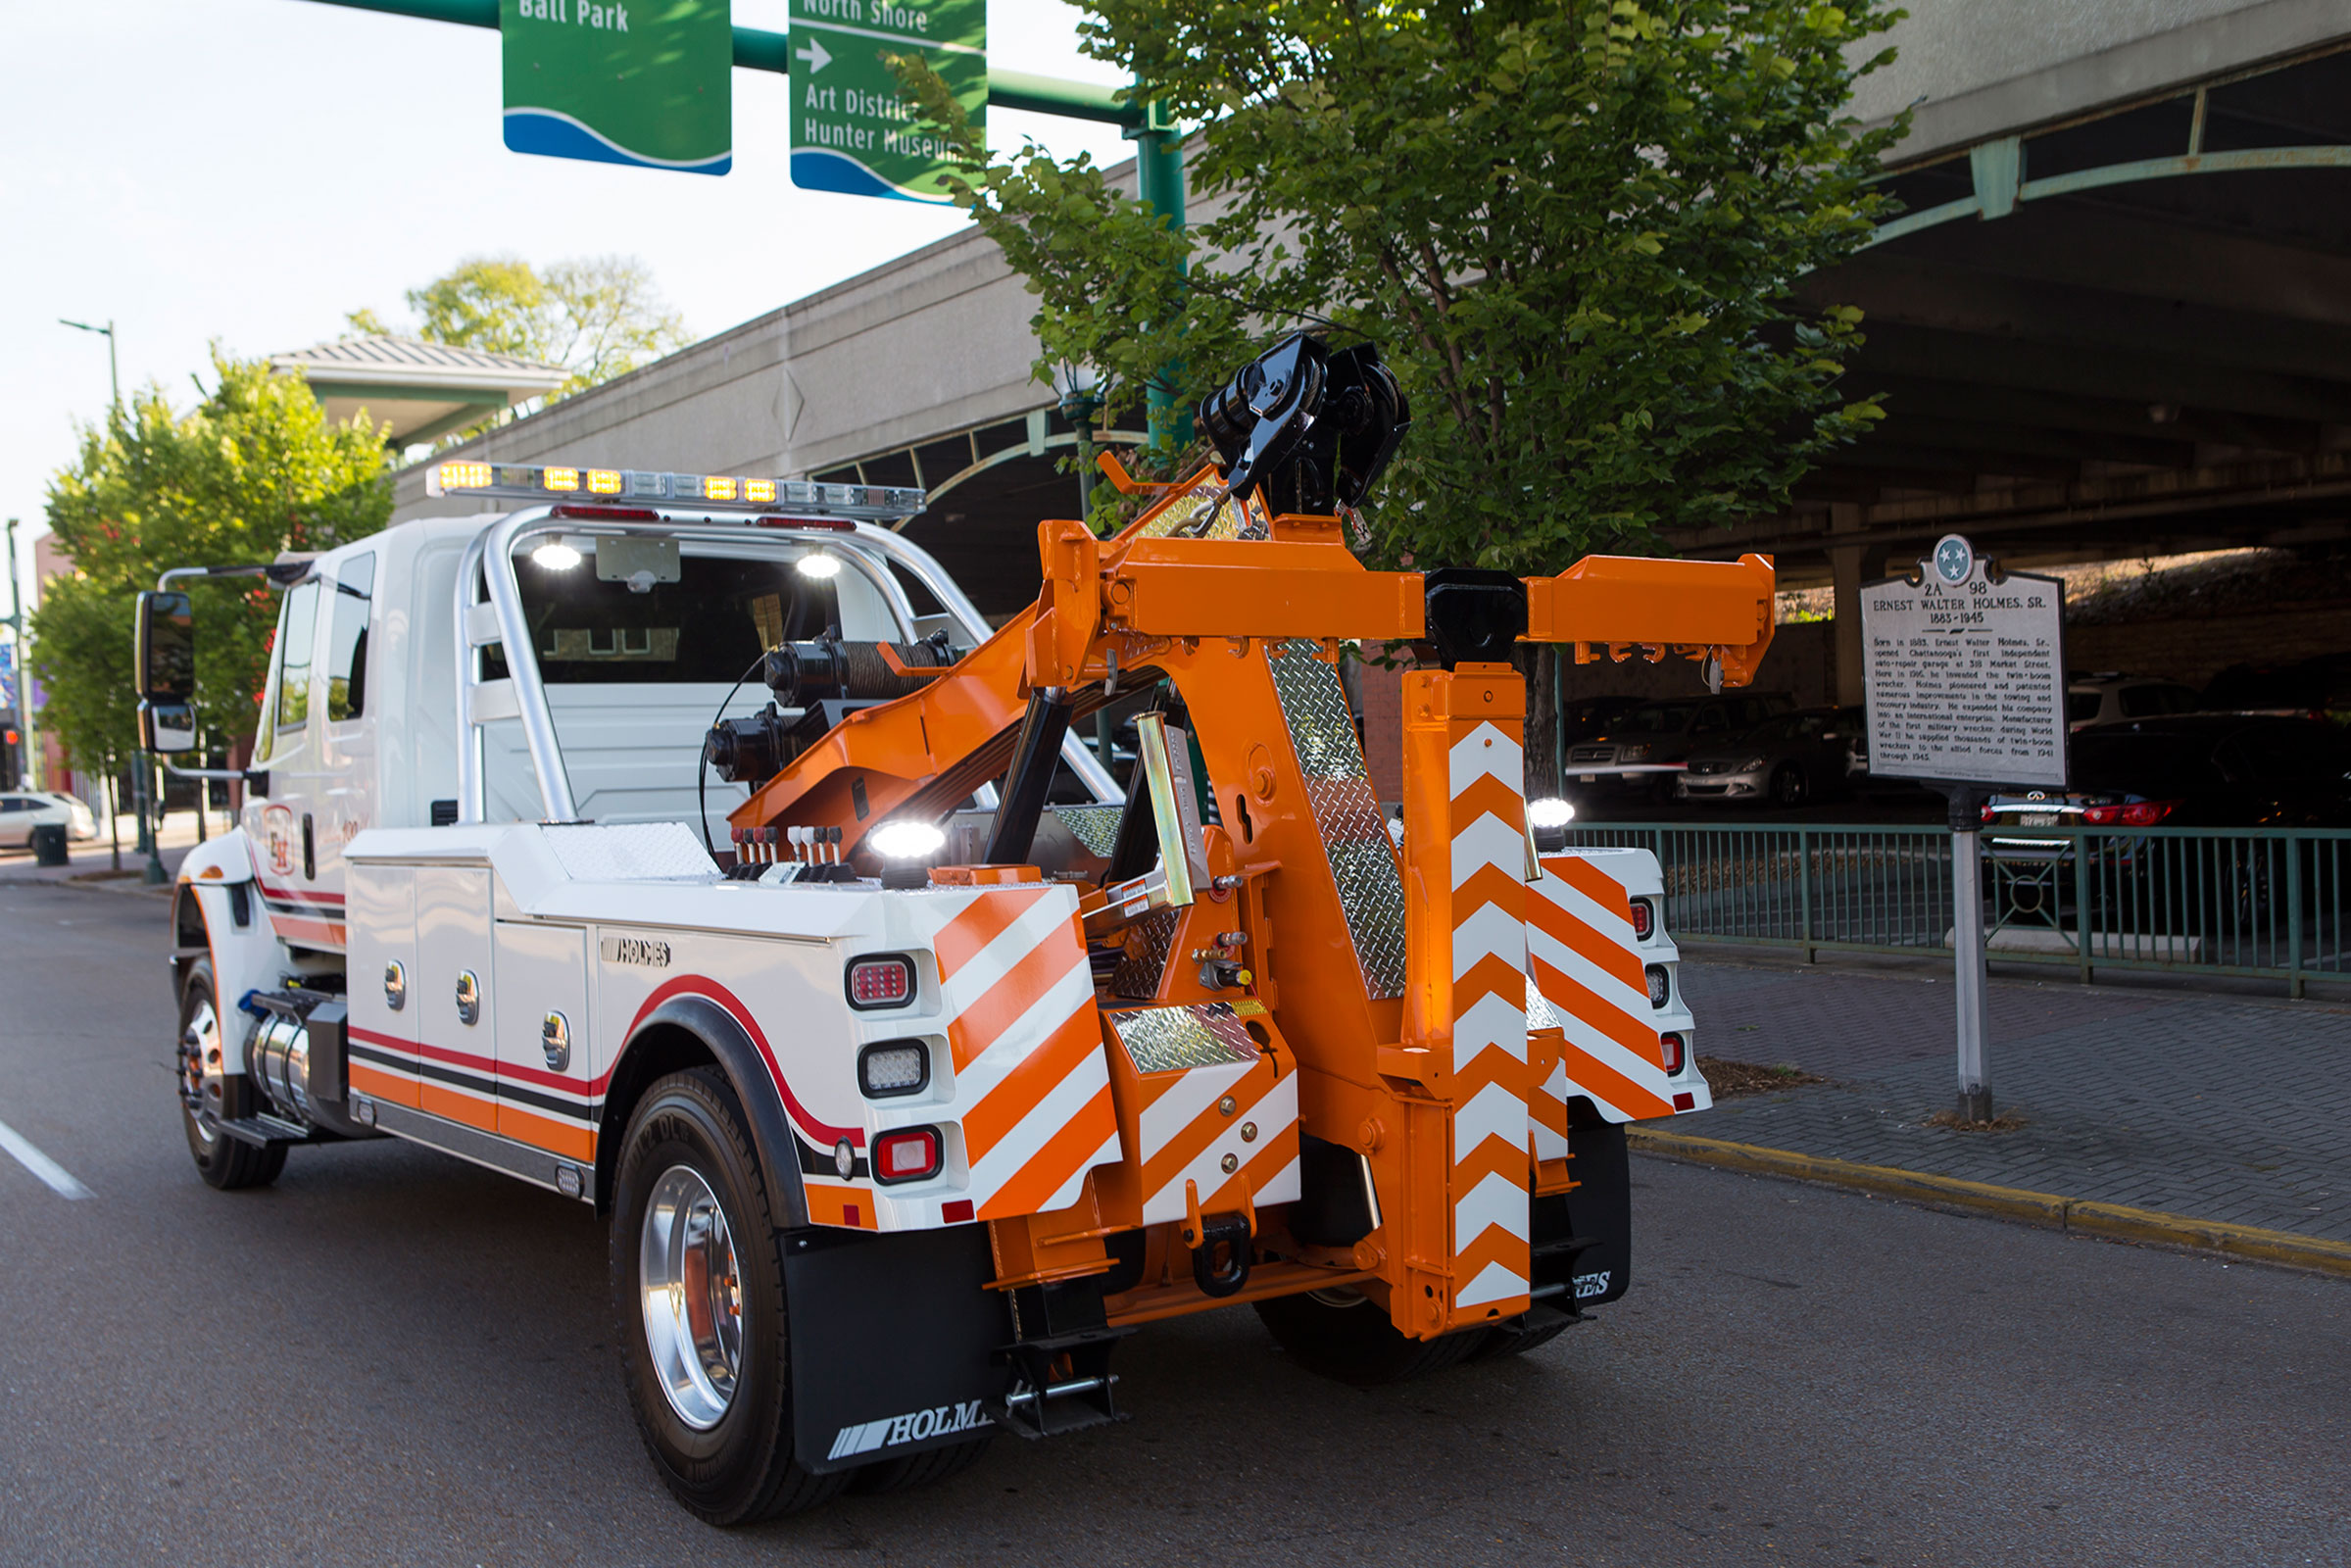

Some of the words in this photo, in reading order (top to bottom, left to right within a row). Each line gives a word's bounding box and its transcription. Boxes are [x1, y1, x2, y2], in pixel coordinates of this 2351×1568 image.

[519, 0, 567, 24] Ball
[577, 0, 628, 32] Park
[804, 0, 861, 21] North
[870, 0, 928, 32] Shore
[806, 83, 836, 112] Art
[805, 117, 875, 150] Hunter
[1925, 583, 1942, 597] 2A
[1969, 581, 1987, 595] 98
[1874, 600, 1913, 612] ERNEST
[1921, 599, 1965, 611] WALTER
[2028, 596, 2046, 609] SR.
[1935, 638, 1959, 647] Ernest
[1973, 649, 1989, 658] first
[1922, 661, 1948, 669] garage
[1989, 660, 2017, 668] Market
[1875, 669, 1892, 678] Here
[1915, 680, 1942, 689] Holmes
[2015, 683, 2051, 692] patented
[2004, 694, 2031, 704] towing
[1947, 702, 1958, 710] He
[2016, 706, 2052, 714] company
[1905, 721, 1921, 730] first
[1927, 723, 1957, 732] military
[2000, 725, 2026, 736] during
[1880, 752, 1908, 761] through
[1979, 746, 2002, 755] forces
[2011, 747, 2030, 756] from
